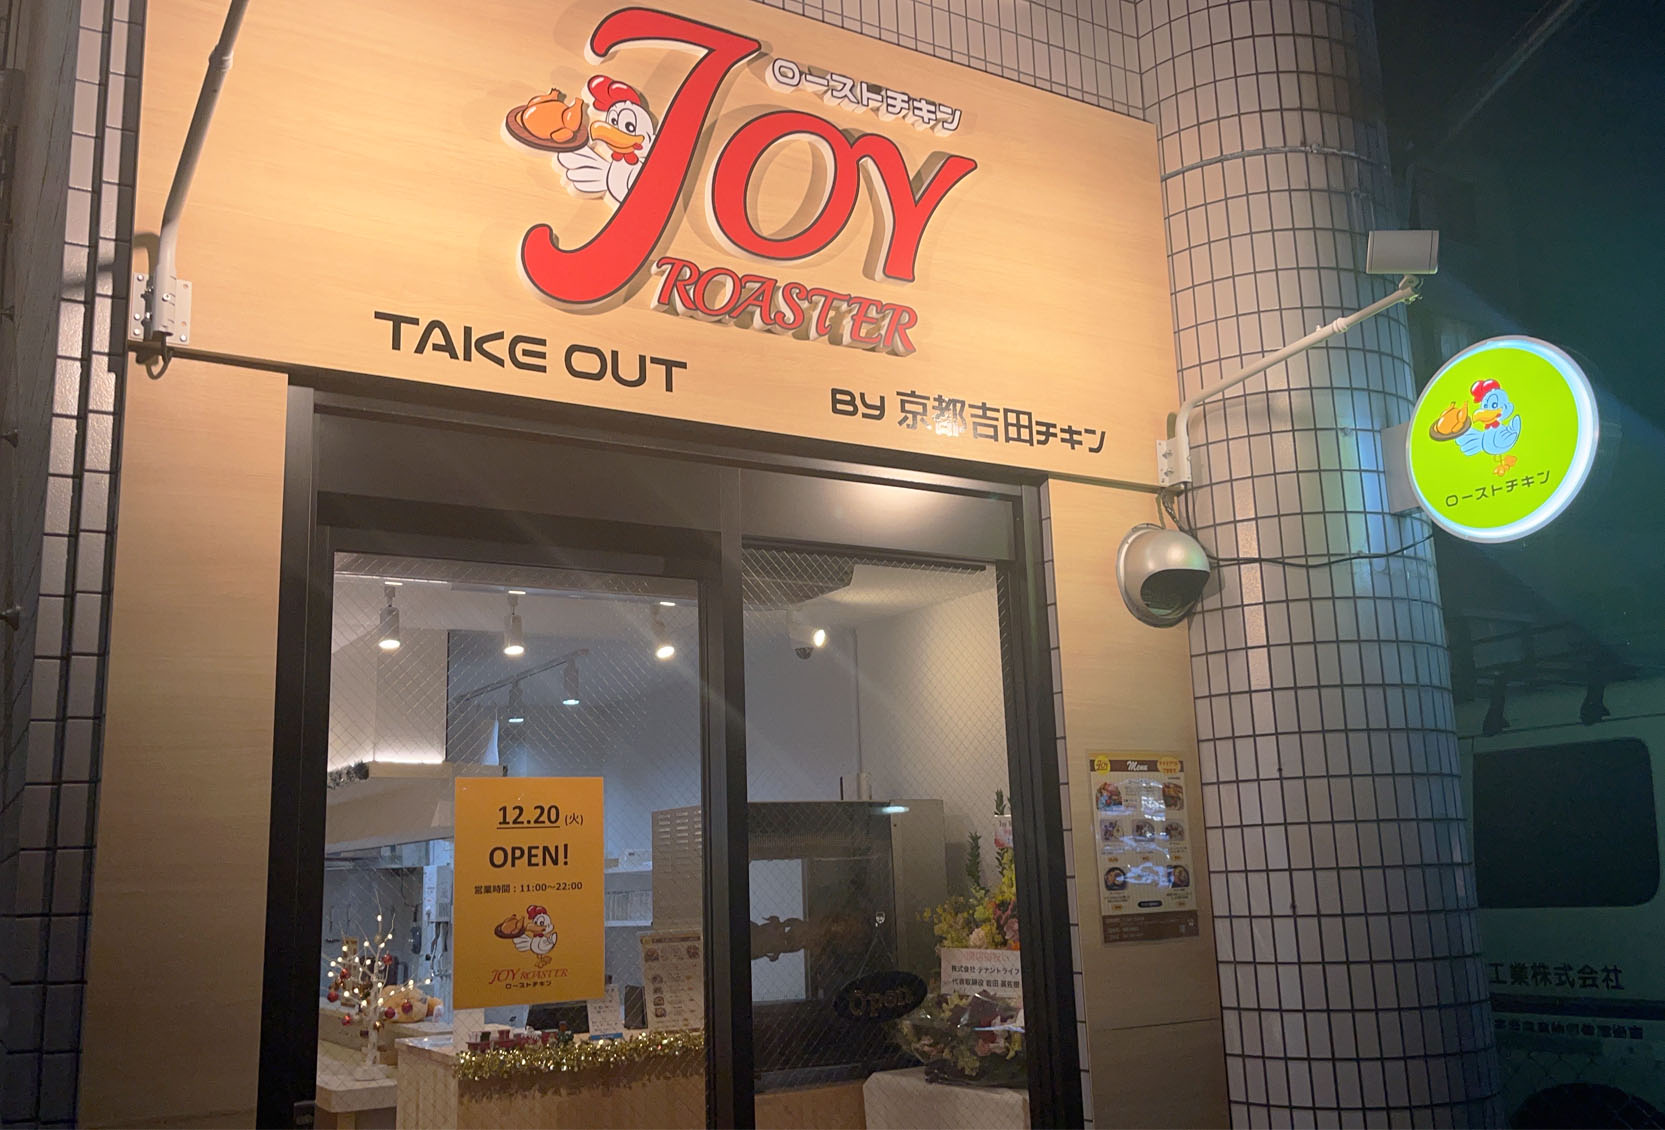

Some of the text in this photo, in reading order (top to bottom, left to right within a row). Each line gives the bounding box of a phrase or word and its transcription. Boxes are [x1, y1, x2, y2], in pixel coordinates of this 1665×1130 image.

[771, 58, 962, 131] ローストチキン
[521, 7, 977, 303] JOY
[656, 256, 918, 354] ROASTER
[374, 310, 688, 392] TAKE OUT
[896, 390, 1107, 453] 京都吉田チキン
[1445, 470, 1550, 507] ローストチキン
[1126, 760, 1148, 772] Menu
[498, 805, 560, 825] 12.20
[489, 843, 569, 868] OPEN!
[489, 967, 522, 985] JOY
[1488, 962, 1625, 990] 工業株式会社
